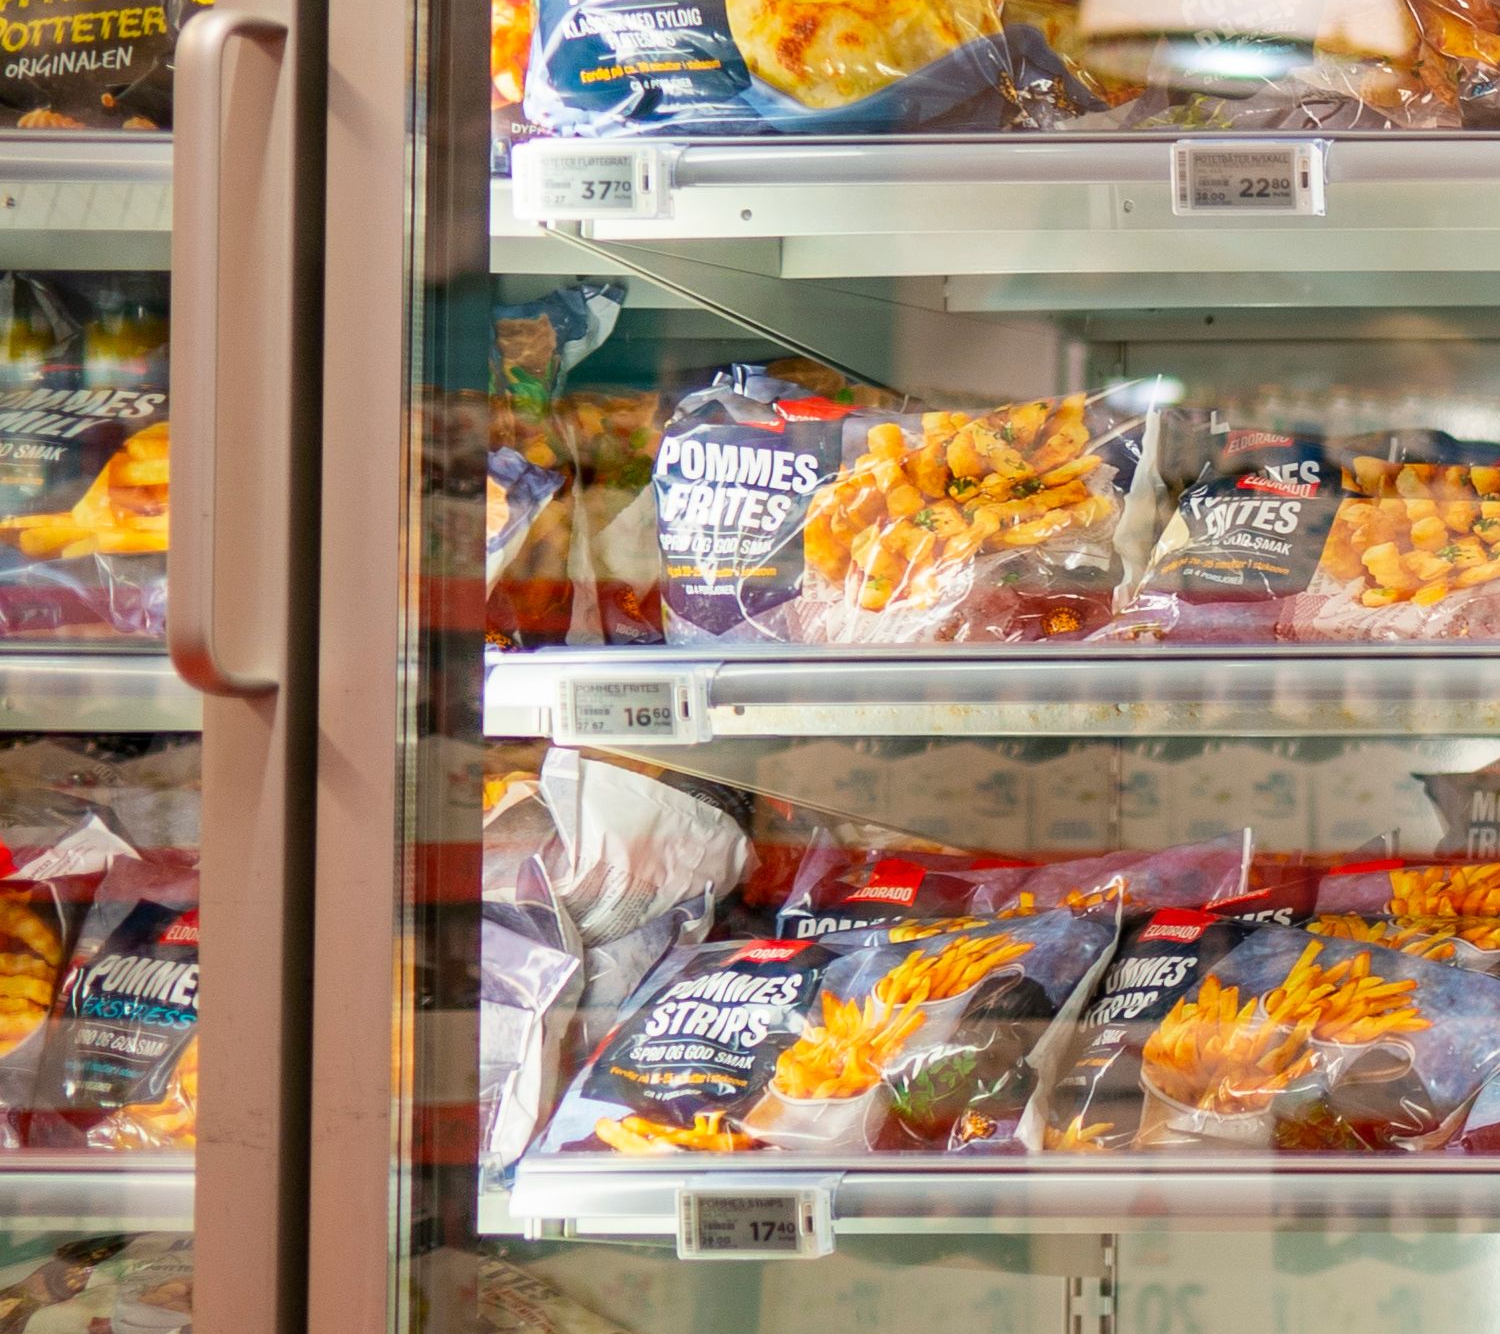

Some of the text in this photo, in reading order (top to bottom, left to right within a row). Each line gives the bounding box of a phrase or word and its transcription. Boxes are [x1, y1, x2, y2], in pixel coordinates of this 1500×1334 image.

[5, 46, 134, 79] ORIGINALEN
[660, 970, 804, 1007] POMMES
[645, 1001, 771, 1047] STRIPS
